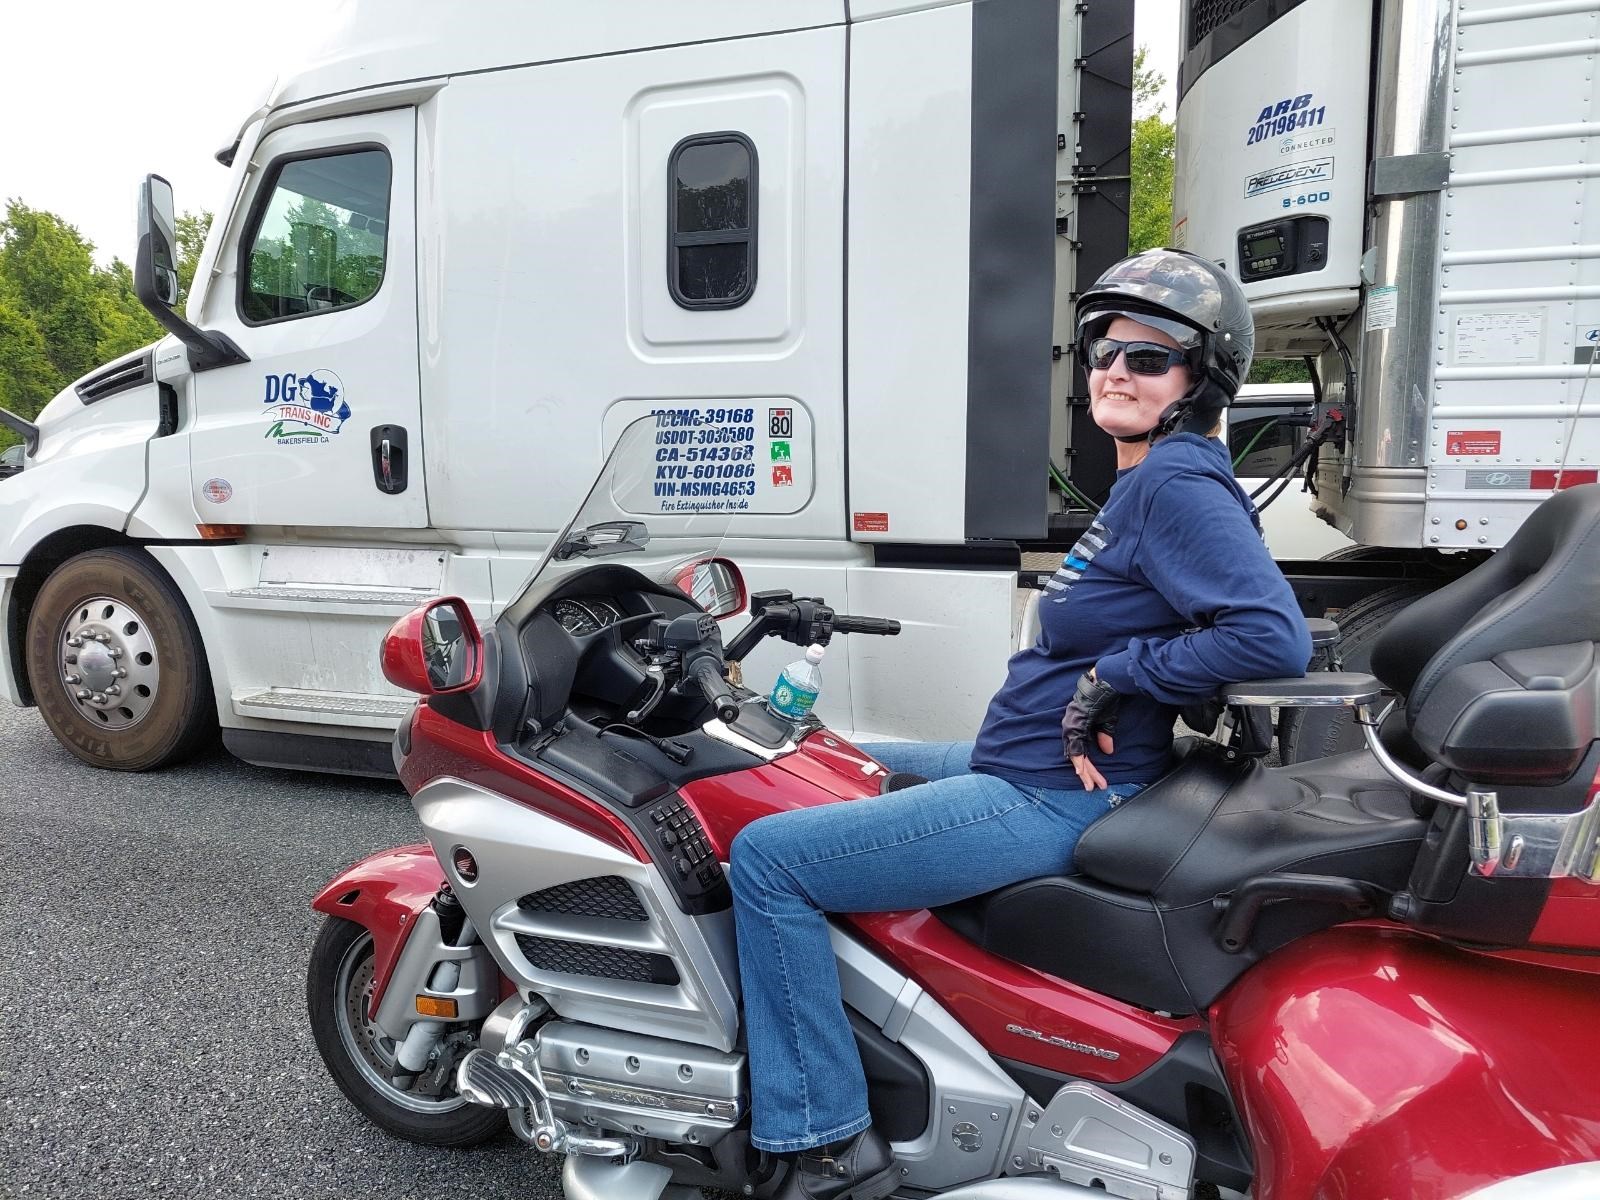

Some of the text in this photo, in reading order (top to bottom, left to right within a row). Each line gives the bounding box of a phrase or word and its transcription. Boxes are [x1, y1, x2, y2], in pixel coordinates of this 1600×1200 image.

[1256, 94, 1312, 123] ARB
[1247, 106, 1325, 146] 207198411
[1280, 137, 1333, 153] CONNECTED
[1247, 162, 1330, 191] PRECEDENT
[1282, 192, 1330, 208] S-600
[264, 373, 297, 403] DG
[280, 407, 331, 428] TRANS INC
[771, 416, 789, 435] 80
[277, 437, 318, 445] BAKERSFIELD
[655, 445, 754, 462] CA-514368
[655, 464, 755, 480] KYU-601086
[654, 481, 755, 497] VIN-MSMG4653
[661, 500, 675, 511] Fire
[676, 500, 724, 512] Extinguisher
[1006, 1023, 1119, 1060] GOLDWING
